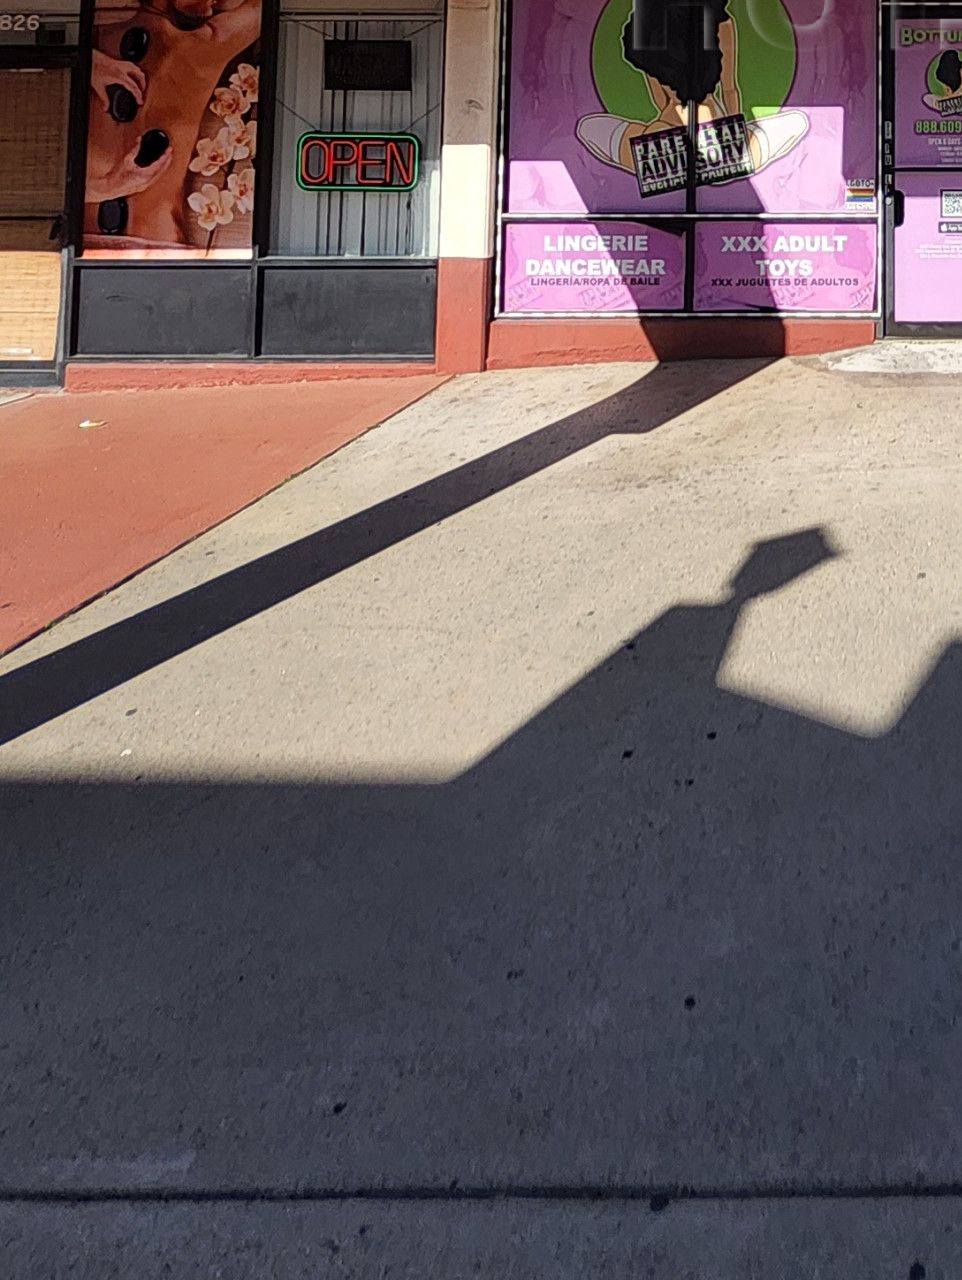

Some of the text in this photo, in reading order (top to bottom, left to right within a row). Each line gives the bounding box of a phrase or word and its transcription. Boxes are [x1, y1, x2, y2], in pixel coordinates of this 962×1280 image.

[0, 14, 40, 31] 826
[635, 119, 745, 161] PARETAL
[301, 139, 414, 184] OPEN
[544, 235, 649, 252] LINGERIE
[721, 235, 848, 252] XXX ADULT
[525, 259, 666, 276] DANCEWEAR
[755, 259, 814, 276] TOYS
[613, 277, 627, 286] DE
[630, 277, 661, 286] BAILE
[711, 278, 859, 287] XXX JUGUETES DE ADULTOS
